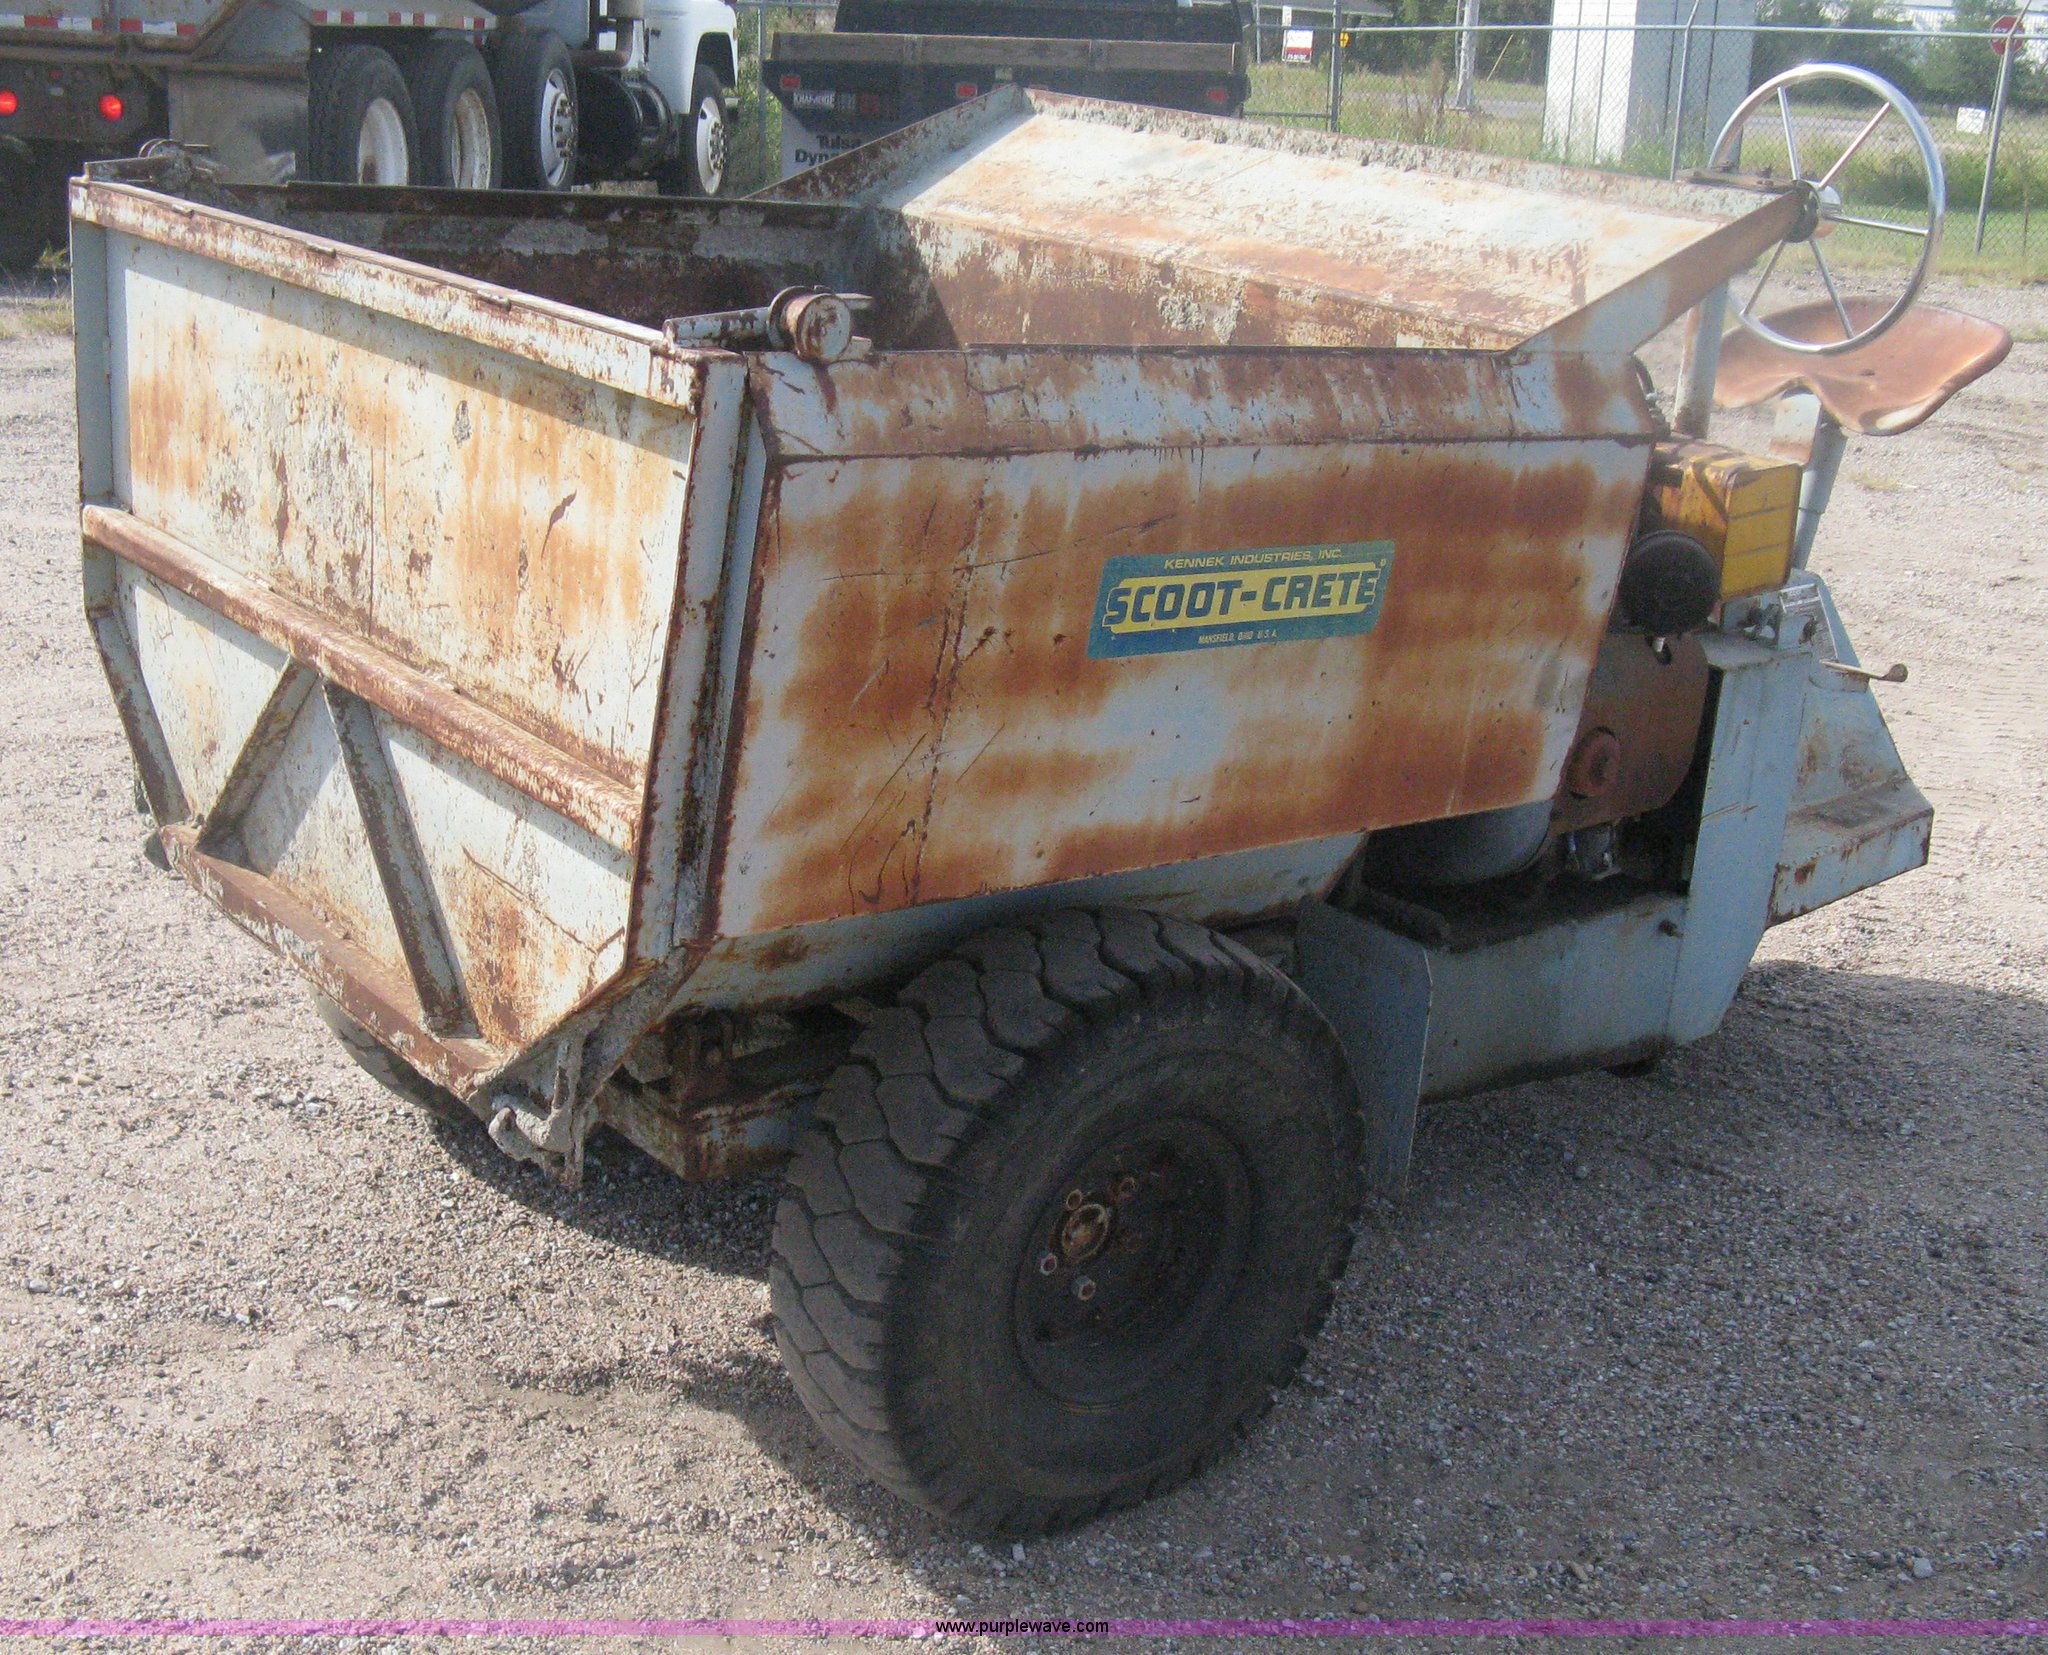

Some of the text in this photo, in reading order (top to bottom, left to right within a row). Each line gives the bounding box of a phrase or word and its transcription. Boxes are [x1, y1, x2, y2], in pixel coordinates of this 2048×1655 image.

[816, 135, 861, 149] Tulsa
[1164, 548, 1343, 569] KENNEK INDUSTRIES, INC.
[1103, 568, 1381, 628] SCOOT-CRETE
[1238, 630, 1254, 641] OHIO
